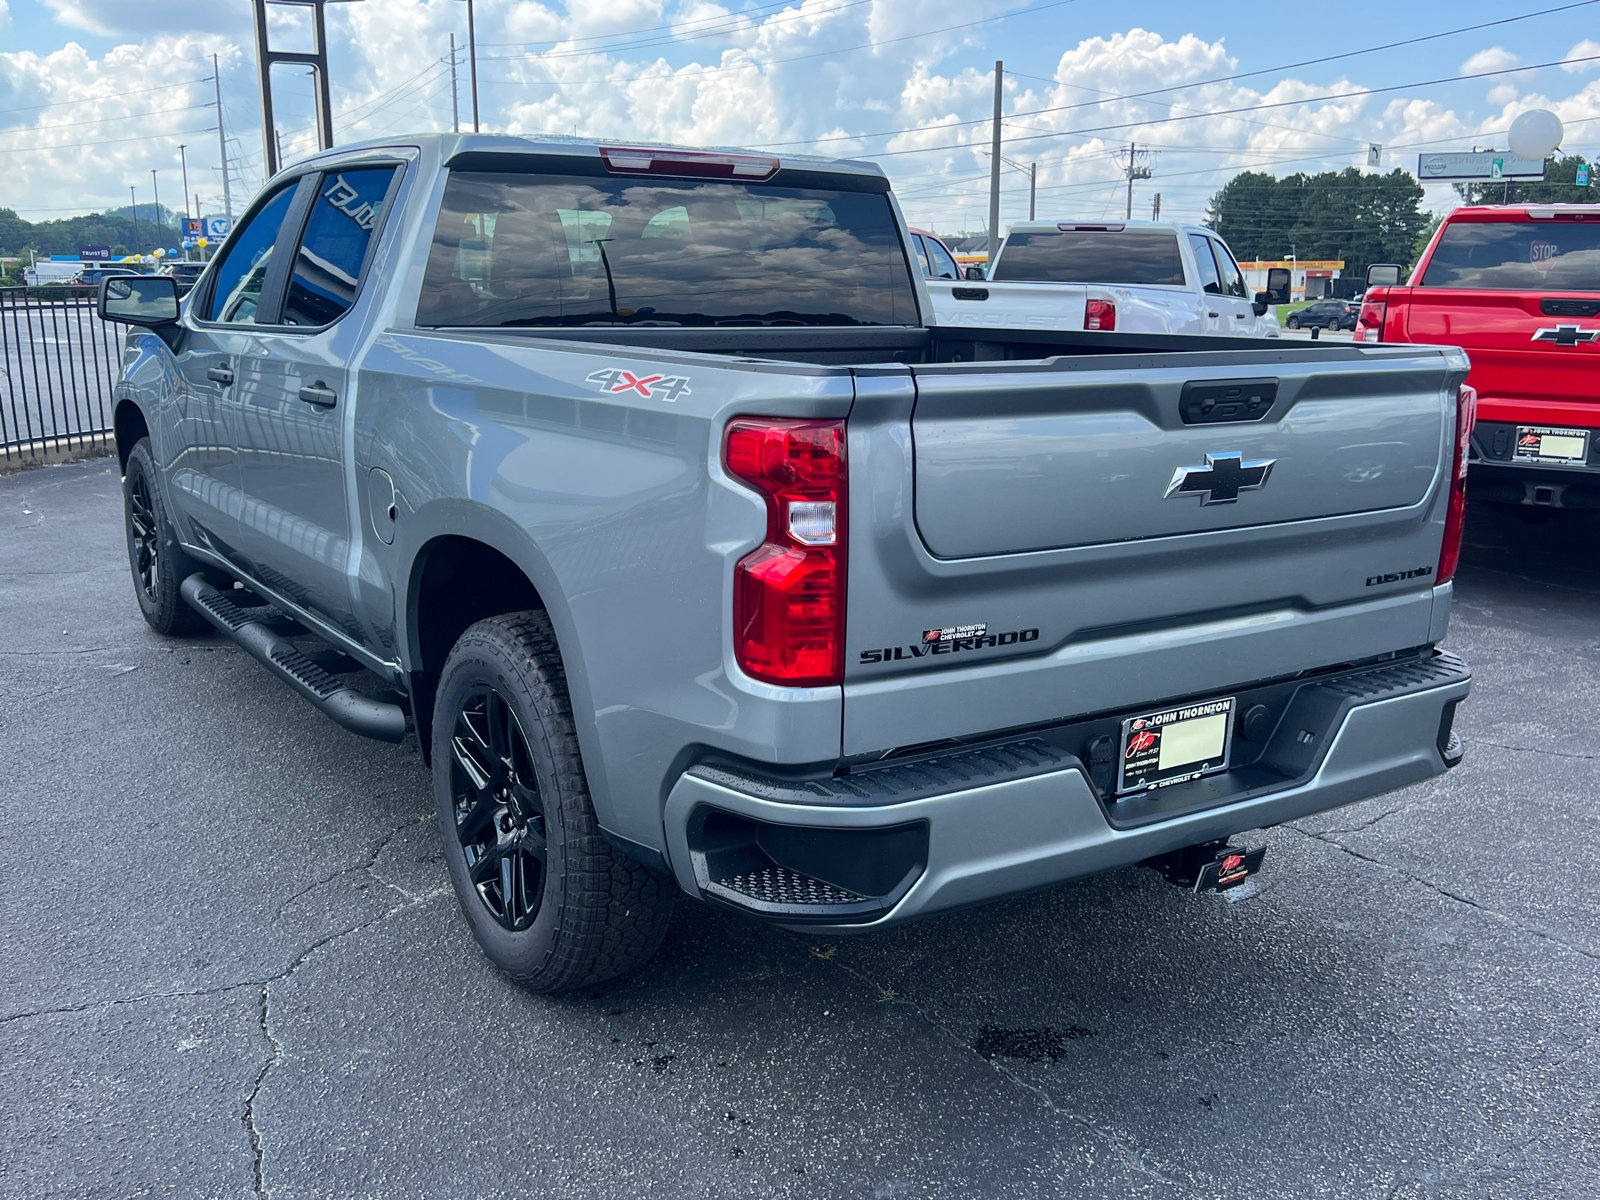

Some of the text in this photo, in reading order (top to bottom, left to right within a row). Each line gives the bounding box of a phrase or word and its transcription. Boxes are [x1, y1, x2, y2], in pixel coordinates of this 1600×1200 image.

[1449, 156, 1490, 165] CERTIFIED
[1475, 165, 1513, 173] VEHES
[1494, 167, 1499, 176] 6
[1532, 244, 1558, 260] STOP
[1366, 565, 1433, 587] CUSTOM
[940, 622, 986, 635] JOHN THORNTON
[940, 630, 975, 641] CHEVROLET
[860, 628, 1039, 664] SILVERADO
[1150, 700, 1231, 727] JOHN THORNTON
[1159, 775, 1191, 787] CHEVROLET
